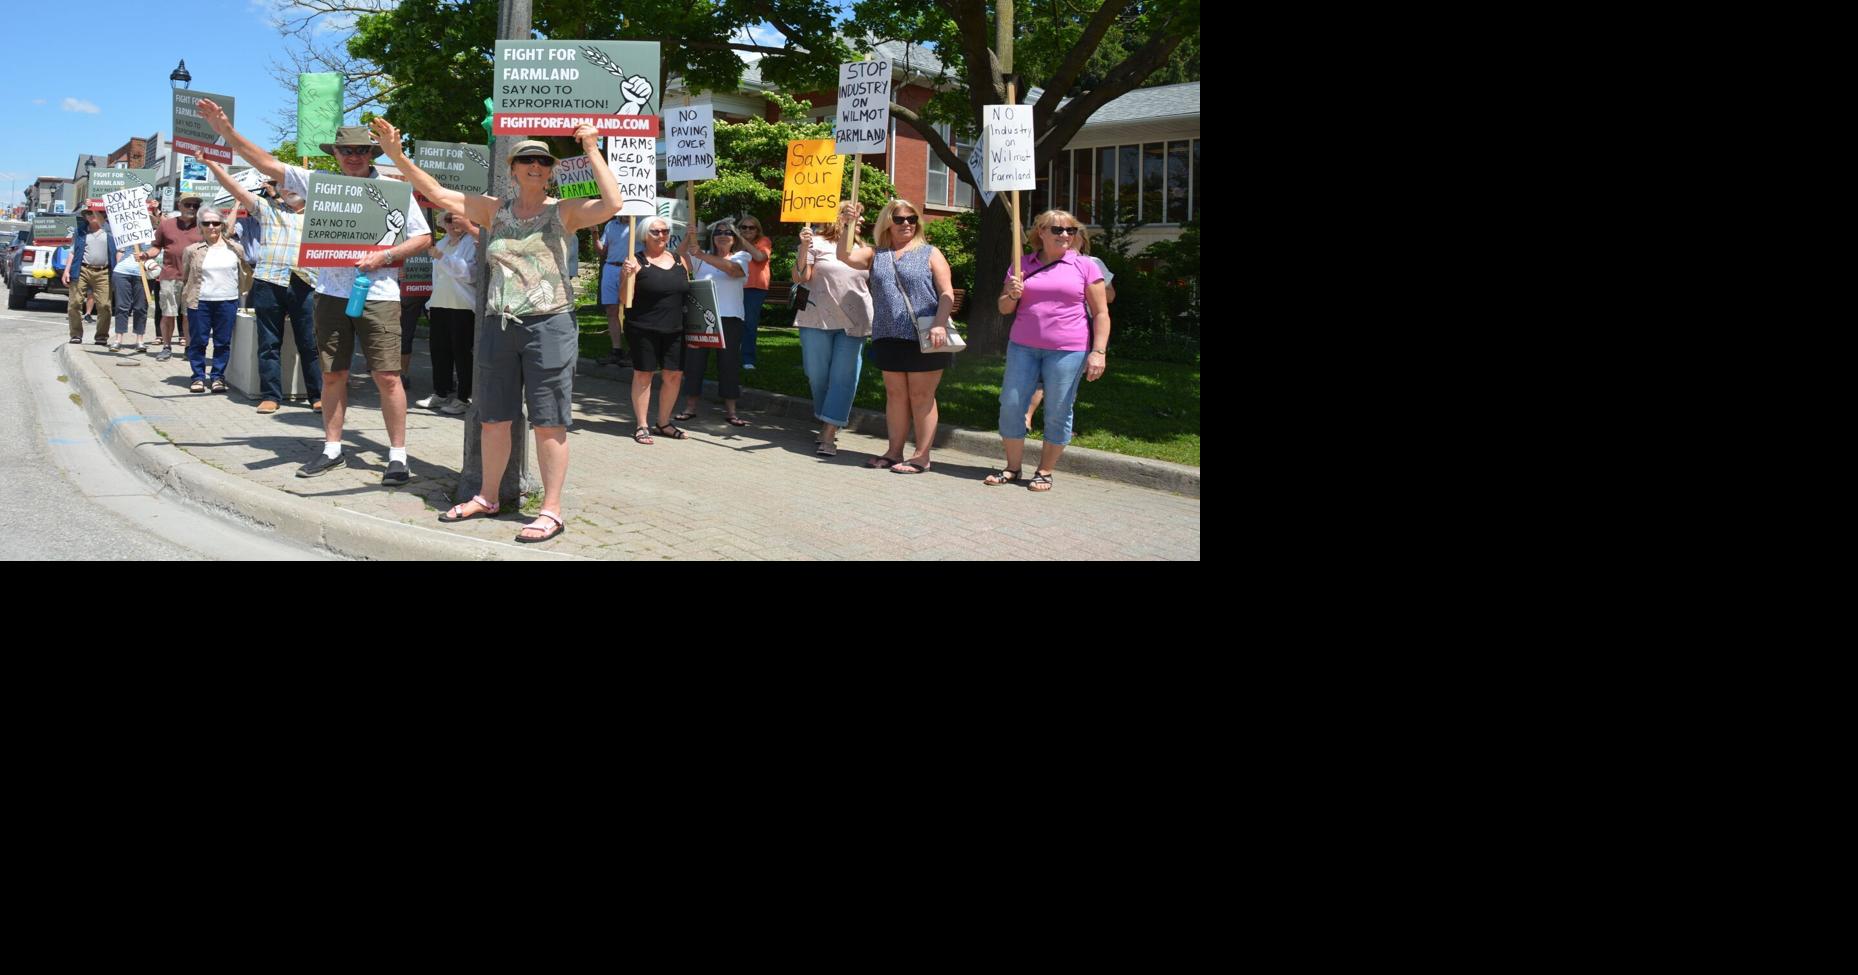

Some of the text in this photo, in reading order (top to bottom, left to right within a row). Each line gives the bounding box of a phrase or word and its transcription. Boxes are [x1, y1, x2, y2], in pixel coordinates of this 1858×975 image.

[504, 48, 576, 60] FIGHT FOR
[503, 68, 580, 80] FARMLAND
[848, 62, 887, 80] STOP
[502, 86, 572, 94] SAY NO TO
[839, 81, 888, 98] INDUSTRY
[502, 98, 608, 108] EXPROPRIATION!
[852, 98, 868, 108] ON
[679, 110, 698, 122] NO
[842, 108, 884, 122] WILMOT
[672, 126, 708, 138] PAVING
[836, 128, 886, 146] FARMLAND
[990, 124, 1032, 138] Industry
[614, 136, 652, 150] FARMS
[678, 140, 706, 150] OVER
[420, 147, 464, 158] FIGHT FOR
[611, 152, 642, 164] NEED
[791, 144, 838, 166] Save
[992, 148, 1031, 163] Wilmot
[420, 160, 464, 171] FARMLAND
[668, 153, 714, 168] FARMLAND
[560, 169, 594, 184] PAVIN
[618, 166, 650, 178] STAY
[794, 171, 832, 184] our
[992, 166, 1030, 182] Farmland
[106, 188, 138, 204] DON'T
[315, 182, 362, 196] FIGHT FOR
[106, 198, 143, 214] REPLACE
[312, 200, 363, 214] FARMLAND
[782, 190, 836, 212] Homes
[114, 208, 147, 224] FARMS
[310, 218, 356, 228] SAY NO TO
[123, 220, 140, 231] FOR
[114, 228, 153, 246] INDUSTRY
[308, 230, 378, 240] EXPROPRIATION!
